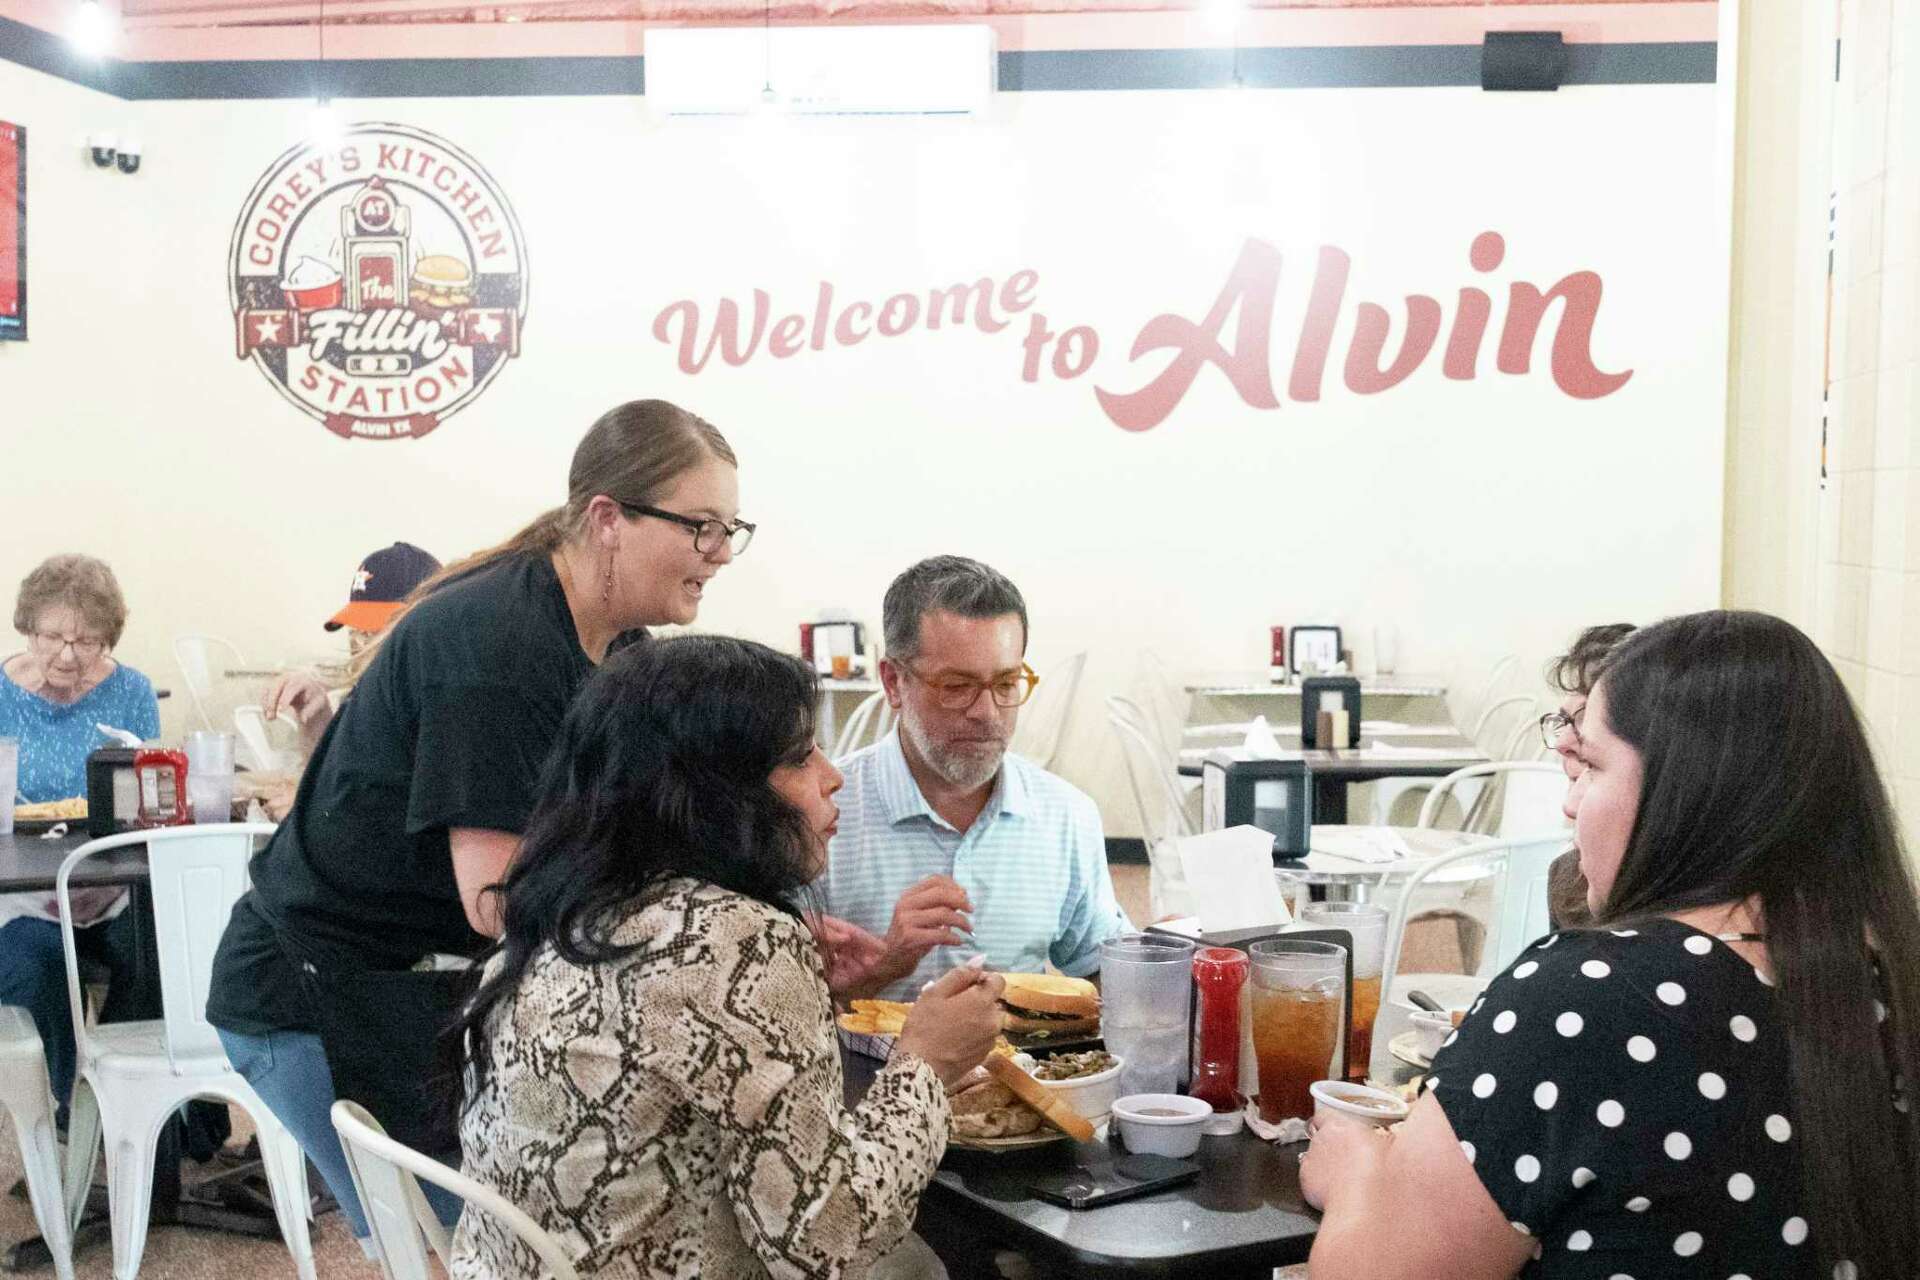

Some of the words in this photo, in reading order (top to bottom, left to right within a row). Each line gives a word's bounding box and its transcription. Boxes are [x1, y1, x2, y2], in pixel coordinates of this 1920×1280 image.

[363, 200, 387, 216] AT
[377, 143, 507, 260] KITCHEN
[360, 276, 395, 300] The
[309, 308, 456, 360] Fillin'
[652, 269, 1039, 375] Welcome
[1022, 313, 1099, 383] to
[1094, 230, 1634, 432] Alvin
[299, 356, 469, 413] STATION
